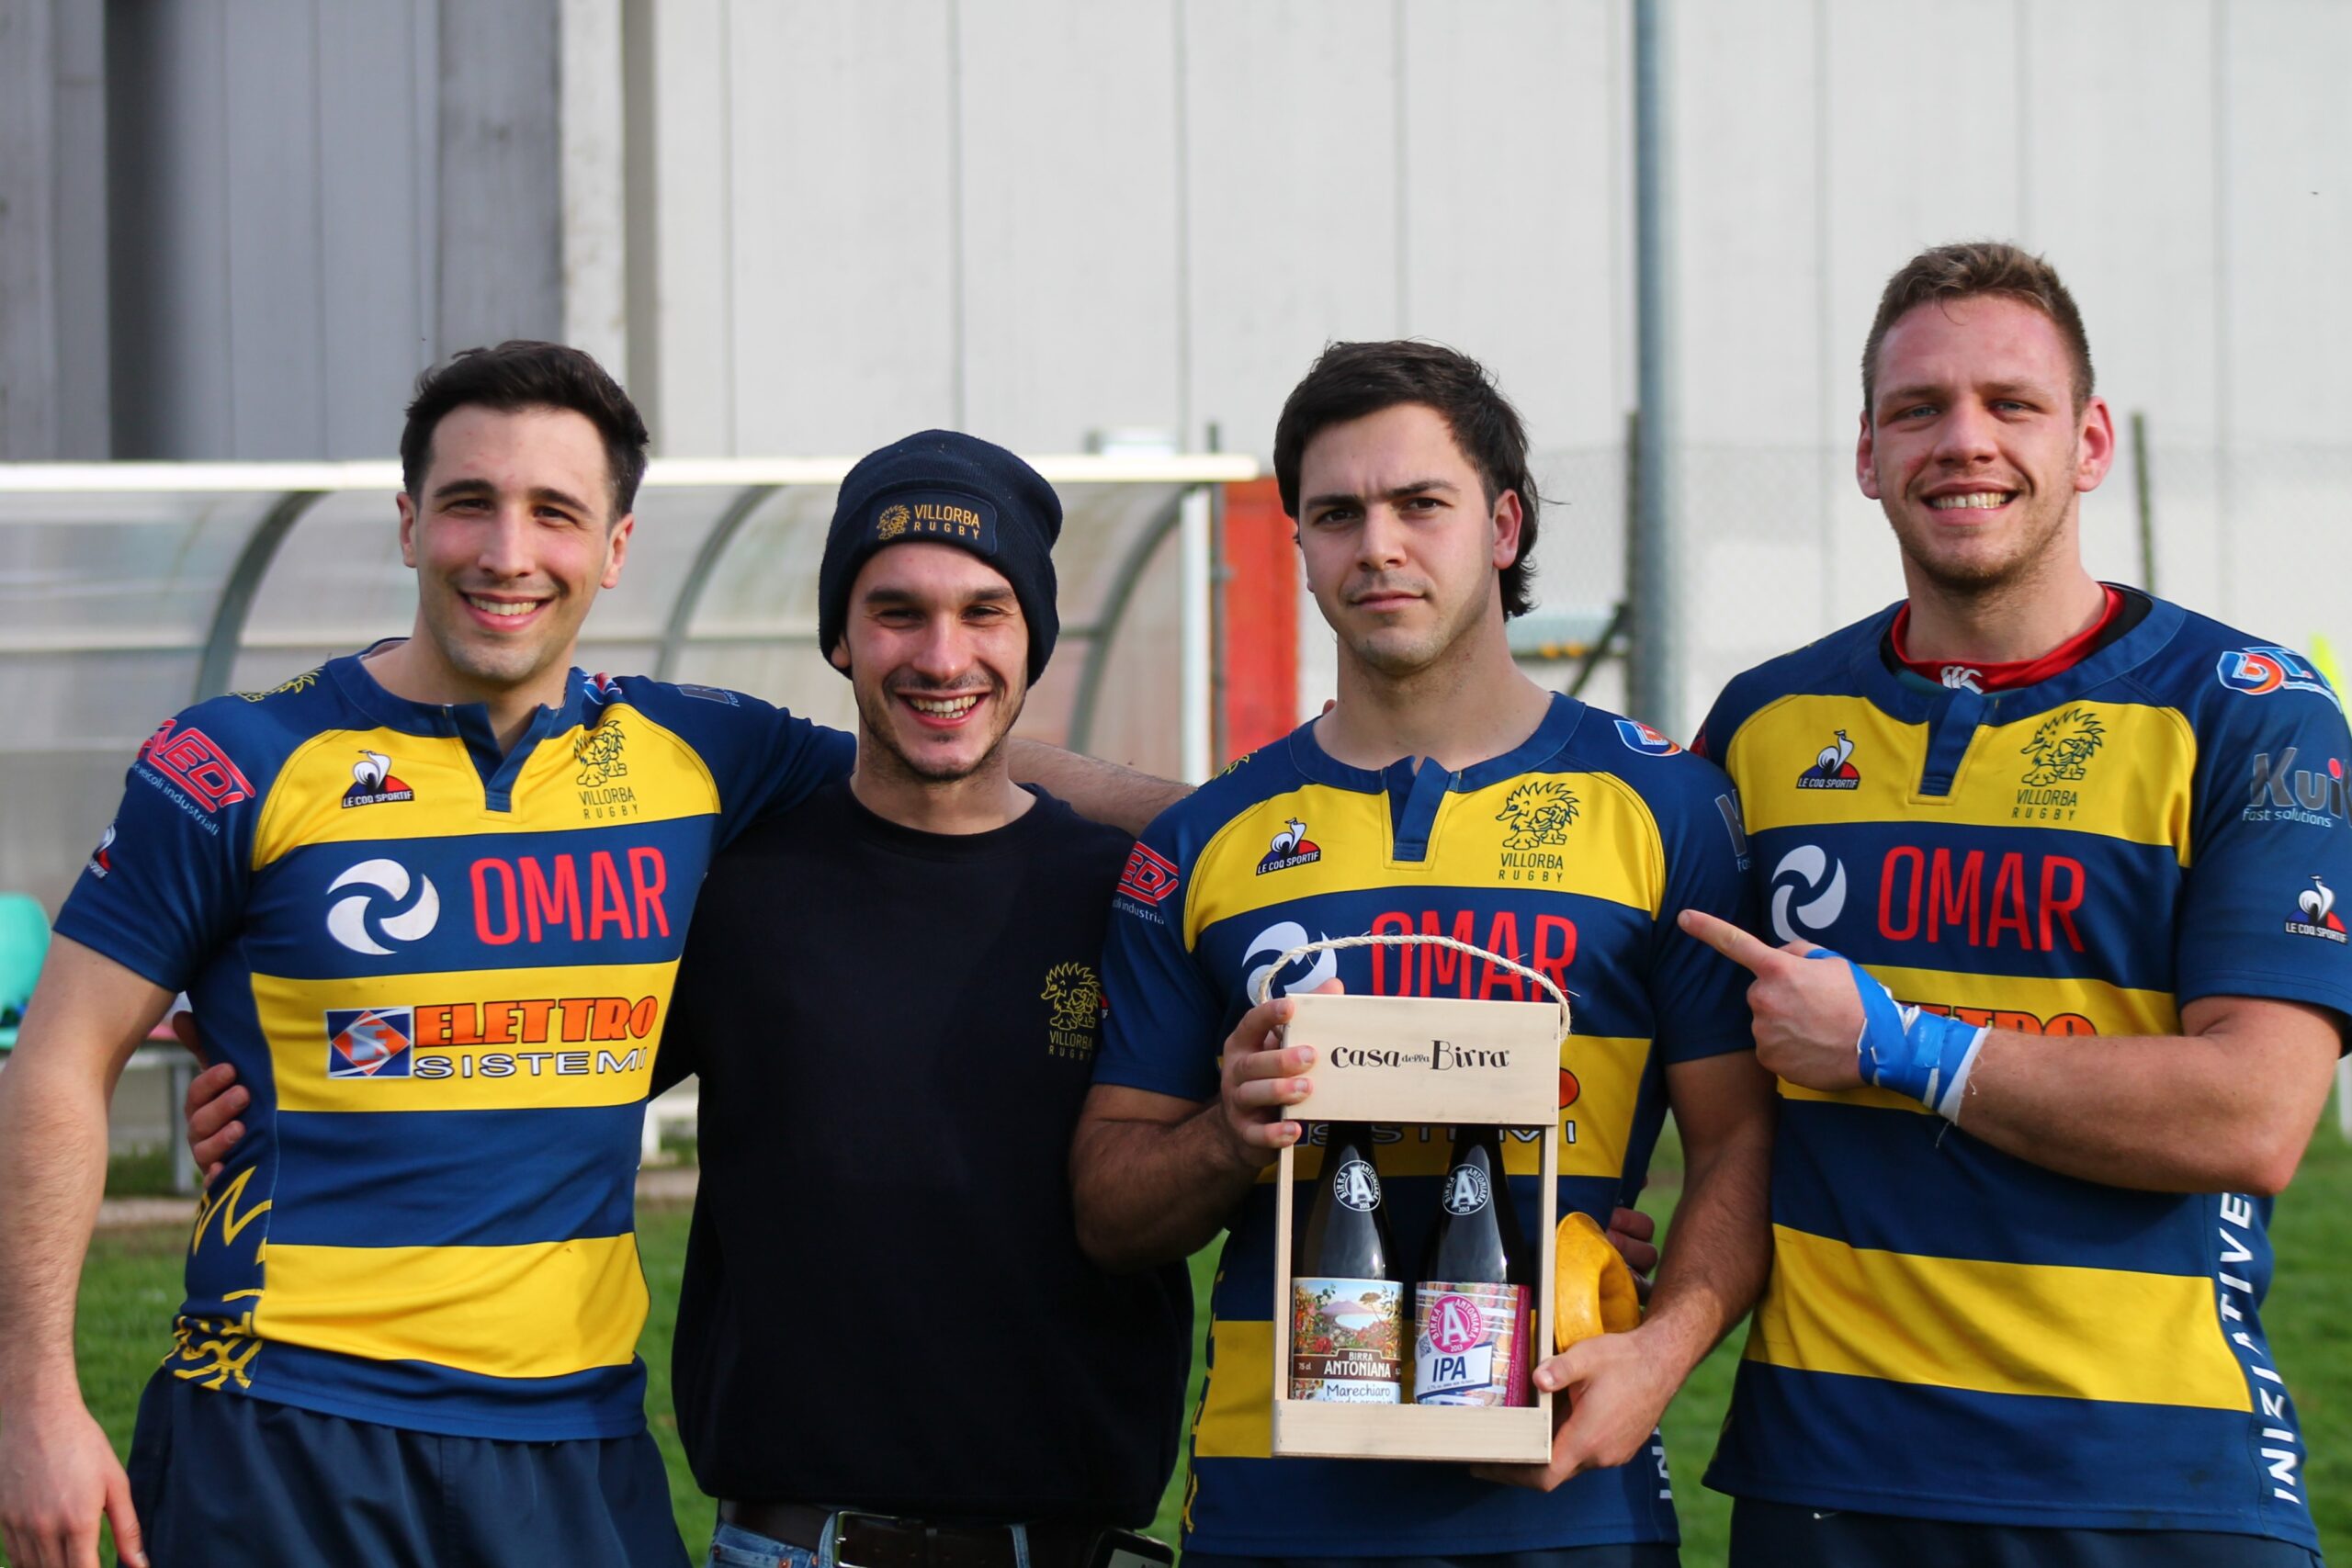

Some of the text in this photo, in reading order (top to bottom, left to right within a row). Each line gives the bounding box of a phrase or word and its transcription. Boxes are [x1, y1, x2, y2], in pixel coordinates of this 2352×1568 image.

[914, 504, 980, 528] VILLORBA
[913, 522, 980, 540] RUGBY
[1798, 778, 1859, 789] LE COQ SPORTIF
[343, 790, 413, 807] LE COQ SPORTIF
[578, 786, 636, 806] VILLORBA
[2017, 789, 2077, 807] VILLORBA
[164, 785, 220, 836] industriali
[583, 804, 638, 820] RUGBY
[2011, 807, 2075, 821] RUGBY
[2243, 807, 2333, 828] fast solutions
[1258, 851, 1319, 874] LE COQ SPORTIF
[1500, 852, 1564, 870] VILLORBA
[1498, 869, 1563, 883] RUGBY
[469, 846, 671, 946] OMAR
[1878, 845, 2086, 953] OMAR
[2285, 921, 2297, 933] LE
[2298, 923, 2315, 936] COQ
[1371, 909, 1578, 1003] OMAR
[413, 996, 658, 1048] ELETTRO
[1049, 1030, 1093, 1051] VILLORBA
[413, 1047, 648, 1079] SISTEMI
[1401, 1054, 1430, 1064] della
[1350, 1166, 1375, 1204] A
[1452, 1168, 1478, 1208] A
[1430, 1308, 1442, 1340] BIRRA
[1442, 1301, 1471, 1347] A
[1349, 1351, 1373, 1361] BIRRA
[1324, 1360, 1391, 1378] ANTONIANA
[1432, 1356, 1466, 1382] IPA
[1327, 1383, 1390, 1397] Marechiaro
